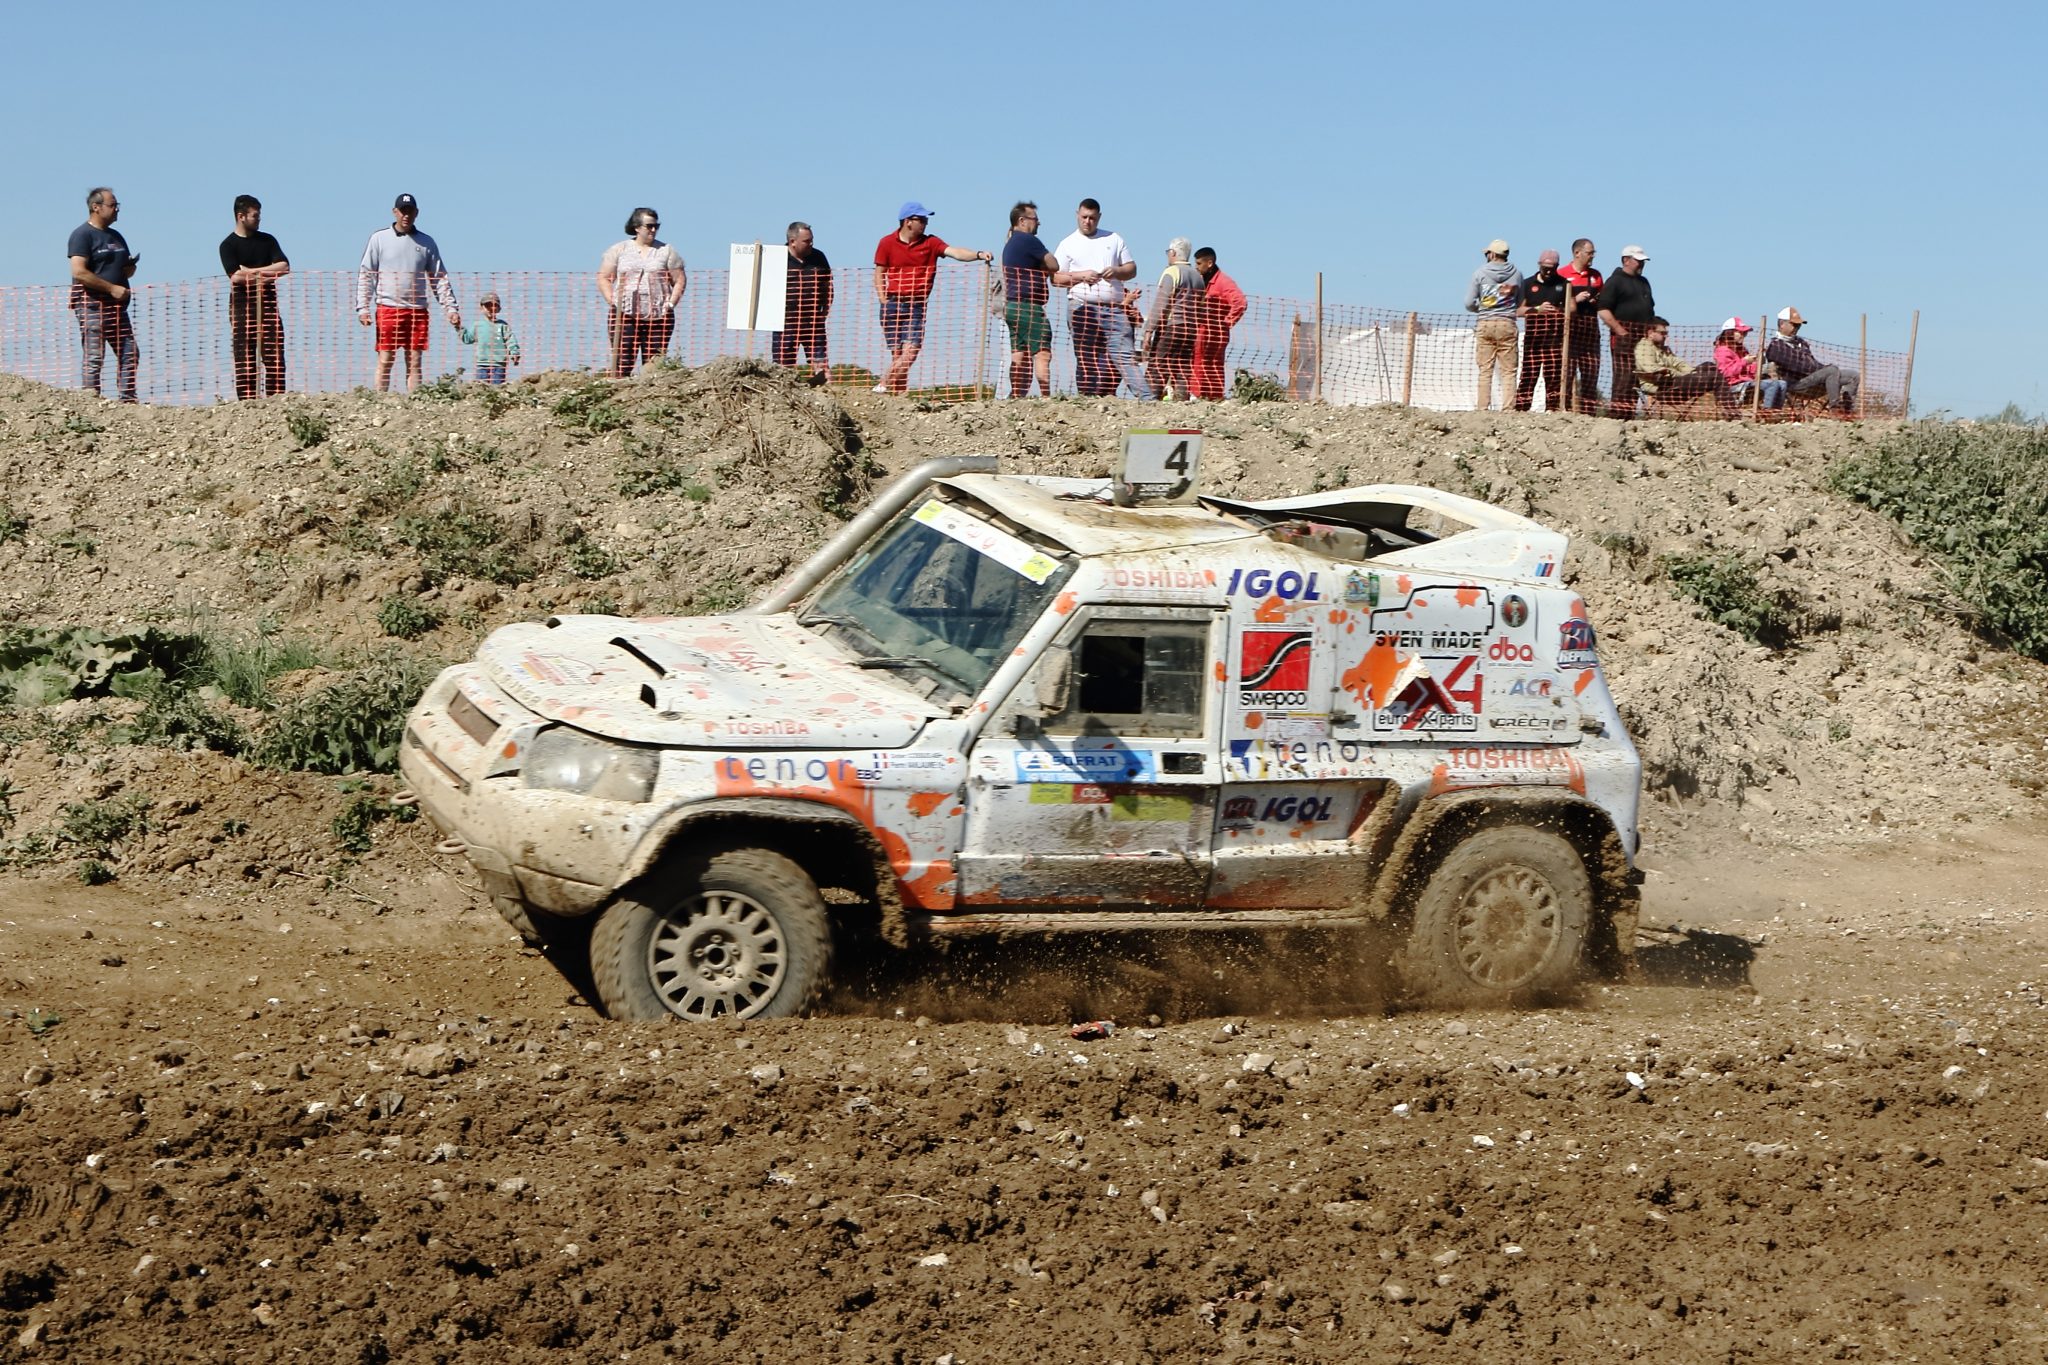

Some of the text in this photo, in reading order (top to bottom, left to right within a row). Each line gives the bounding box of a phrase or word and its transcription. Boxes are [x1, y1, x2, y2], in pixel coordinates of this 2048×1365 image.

[1164, 441, 1189, 476] 4
[1226, 569, 1321, 600] IGOL
[1432, 631, 1482, 648] MADE
[1489, 636, 1533, 661] dba
[1508, 679, 1553, 695] ACR
[1240, 692, 1307, 709] swepco
[725, 722, 810, 734] TOSHIBA
[723, 756, 853, 781] tenor
[1448, 747, 1567, 769] TOSHIBA
[857, 769, 882, 780] EBC
[1261, 797, 1335, 821] IGOL
